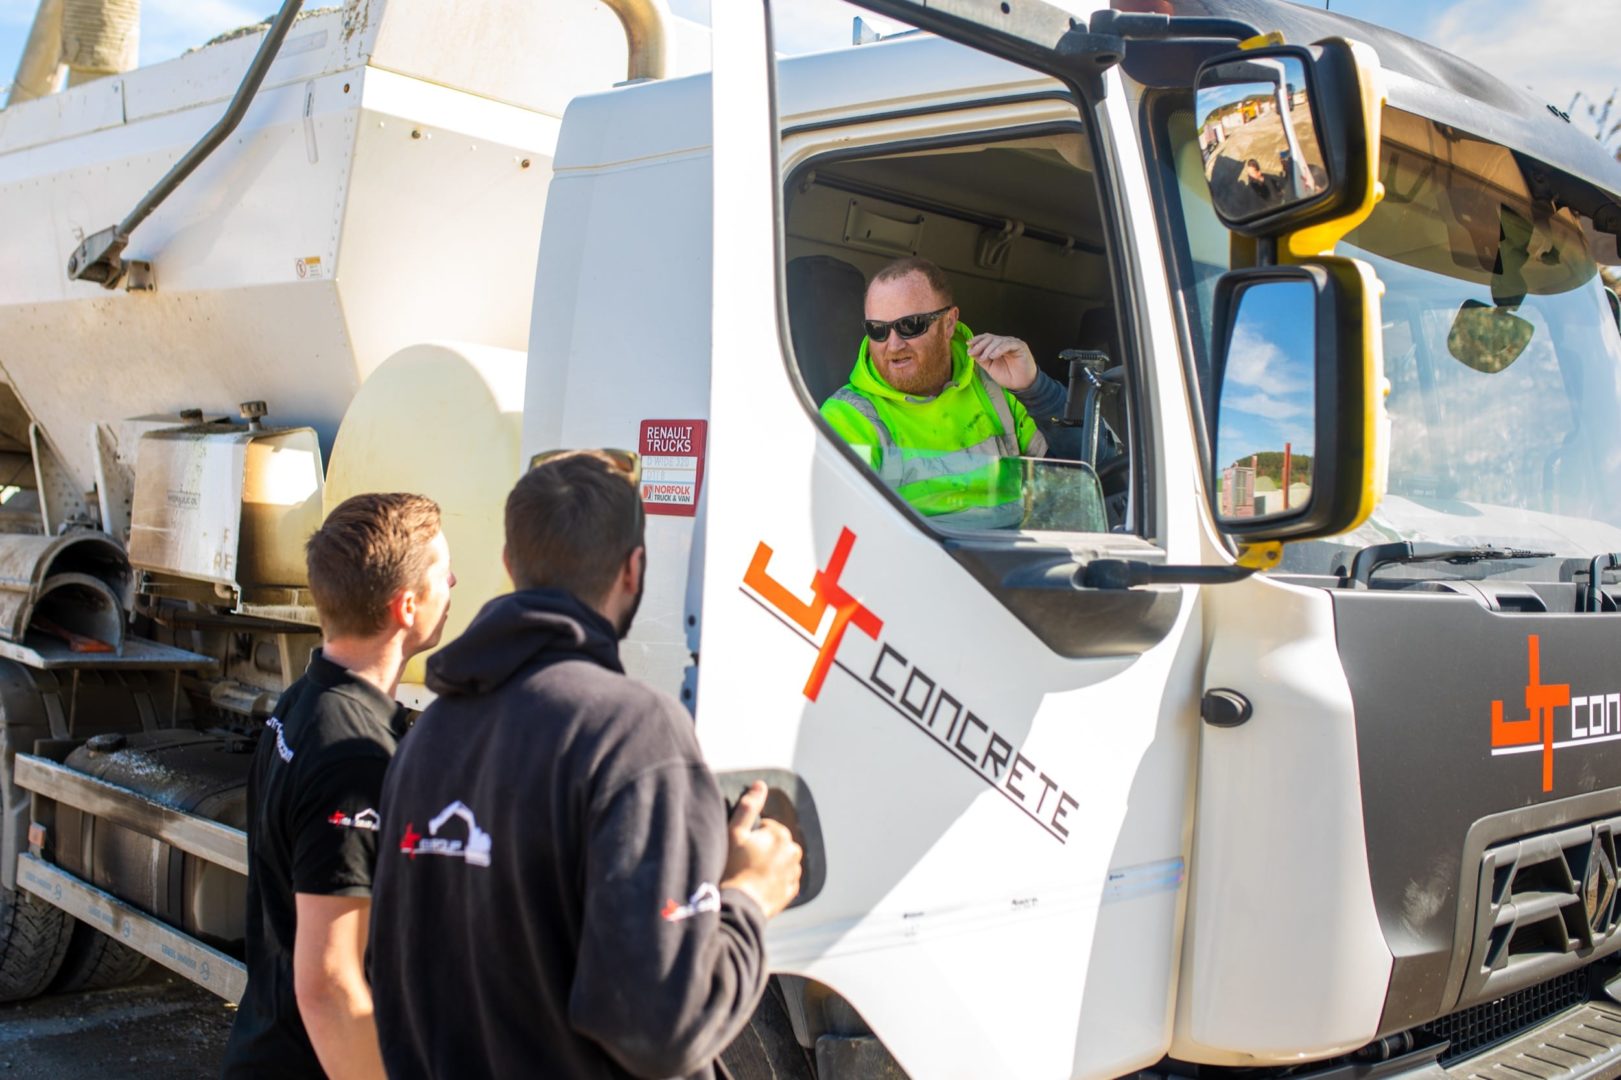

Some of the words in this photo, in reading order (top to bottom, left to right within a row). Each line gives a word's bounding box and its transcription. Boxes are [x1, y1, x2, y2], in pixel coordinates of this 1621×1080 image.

[647, 426, 692, 439] RENAULT
[647, 439, 691, 453] TRUCKS
[654, 485, 691, 495] NORFOLK
[654, 494, 672, 502] TRUCK
[677, 495, 691, 503] VAN
[869, 642, 1080, 838] CONCRETE
